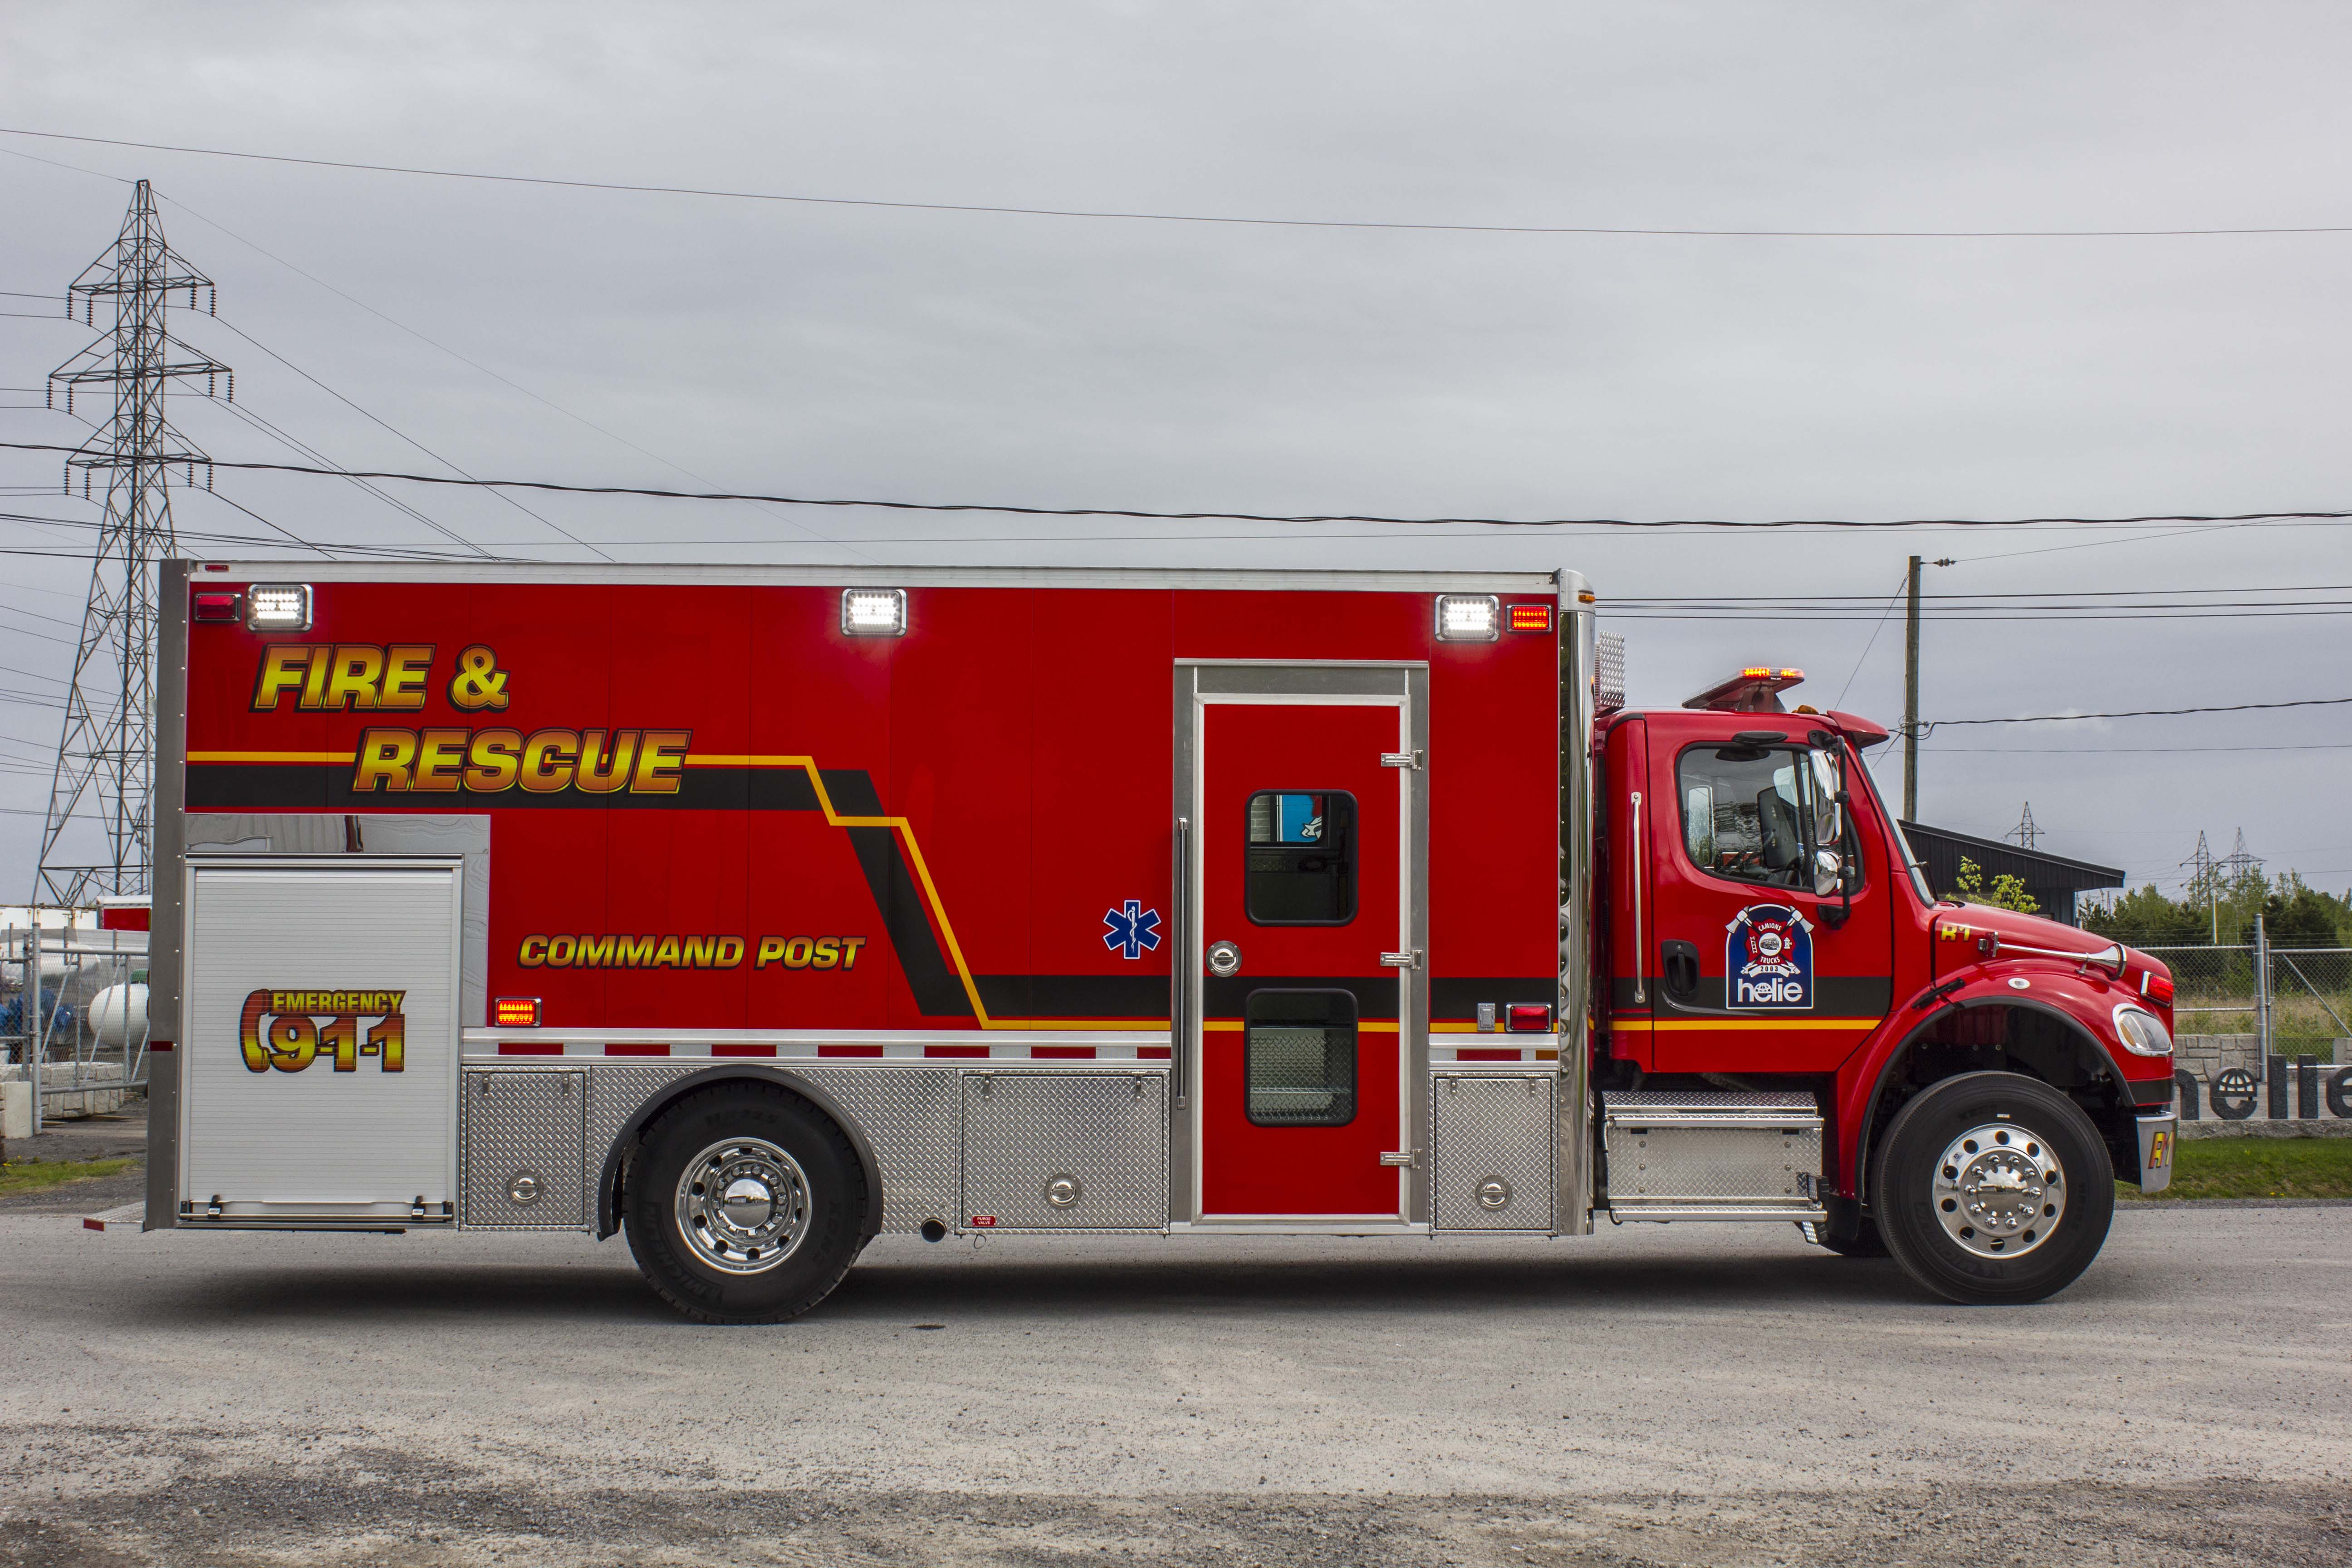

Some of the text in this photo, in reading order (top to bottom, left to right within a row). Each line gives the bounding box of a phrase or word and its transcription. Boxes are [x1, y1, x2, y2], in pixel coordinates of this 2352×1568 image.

[252, 643, 510, 713] FIRE &
[351, 728, 692, 795] RESCUE
[1758, 922, 1782, 931] CAMIONS
[1940, 923, 1970, 942] R1
[518, 934, 867, 972] COMMAND POST
[1760, 956, 1781, 964] TRUCKS
[1737, 978, 1803, 1002] helie
[273, 992, 402, 1013] EMERGENCY
[268, 1013, 405, 1072] 9-1-1
